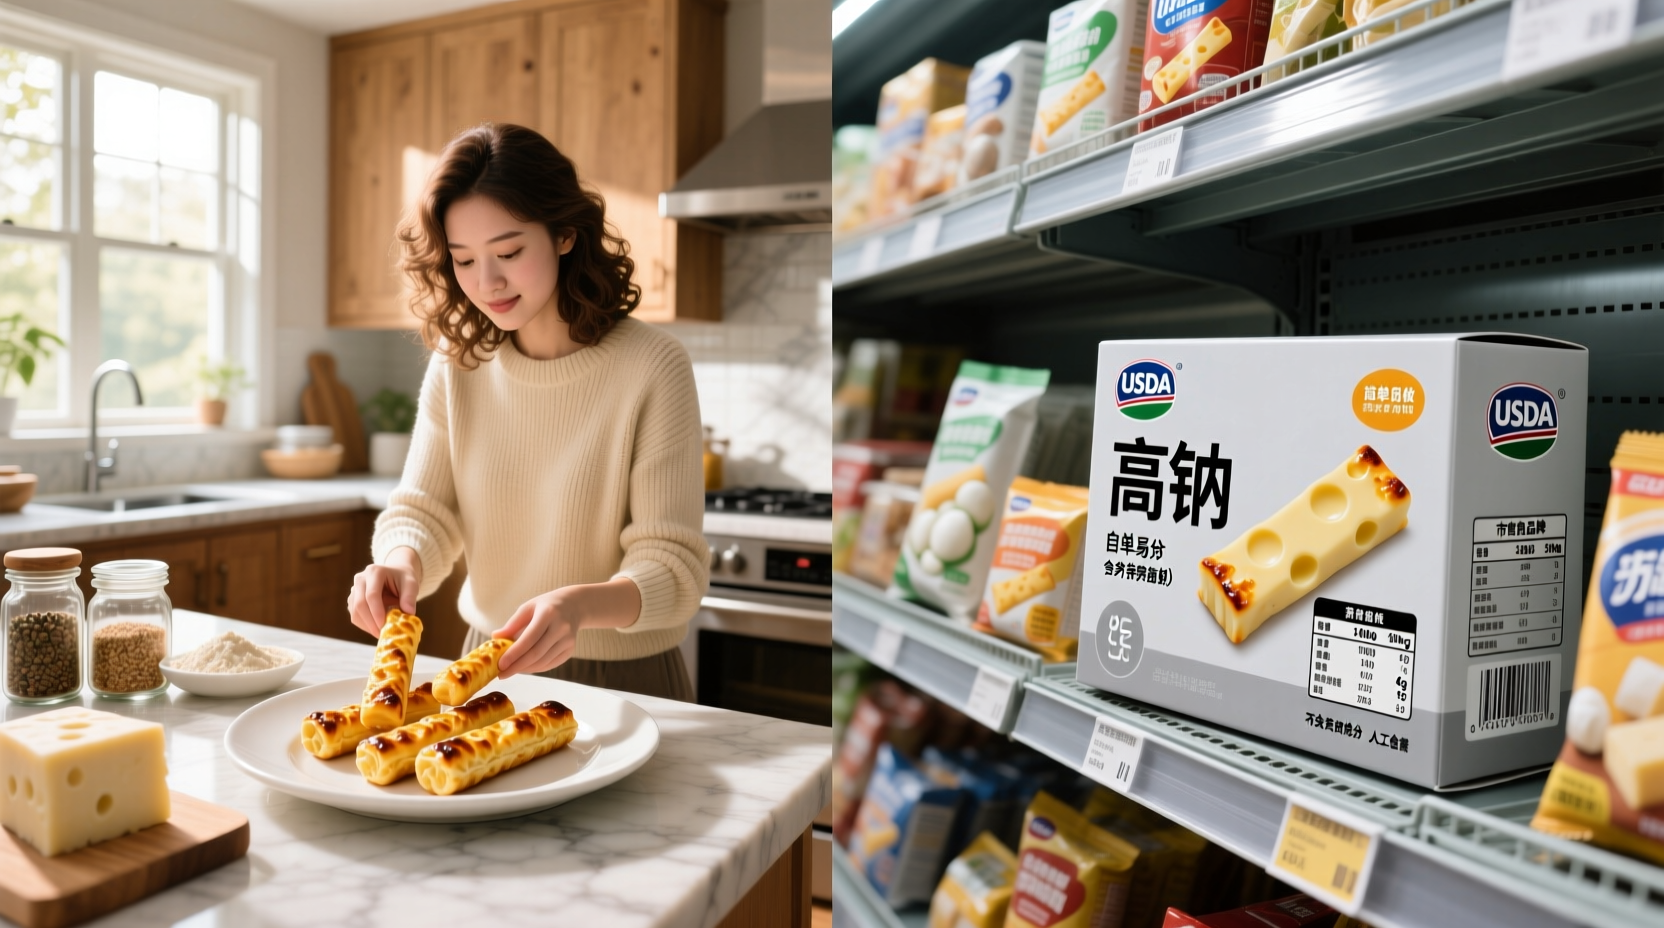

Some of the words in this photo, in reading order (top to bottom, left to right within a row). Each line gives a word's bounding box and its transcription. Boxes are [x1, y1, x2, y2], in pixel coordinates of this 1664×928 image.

[1121, 372, 1172, 396] USDA
[1495, 399, 1554, 427] USDA
[1110, 437, 1233, 529] 高钠
